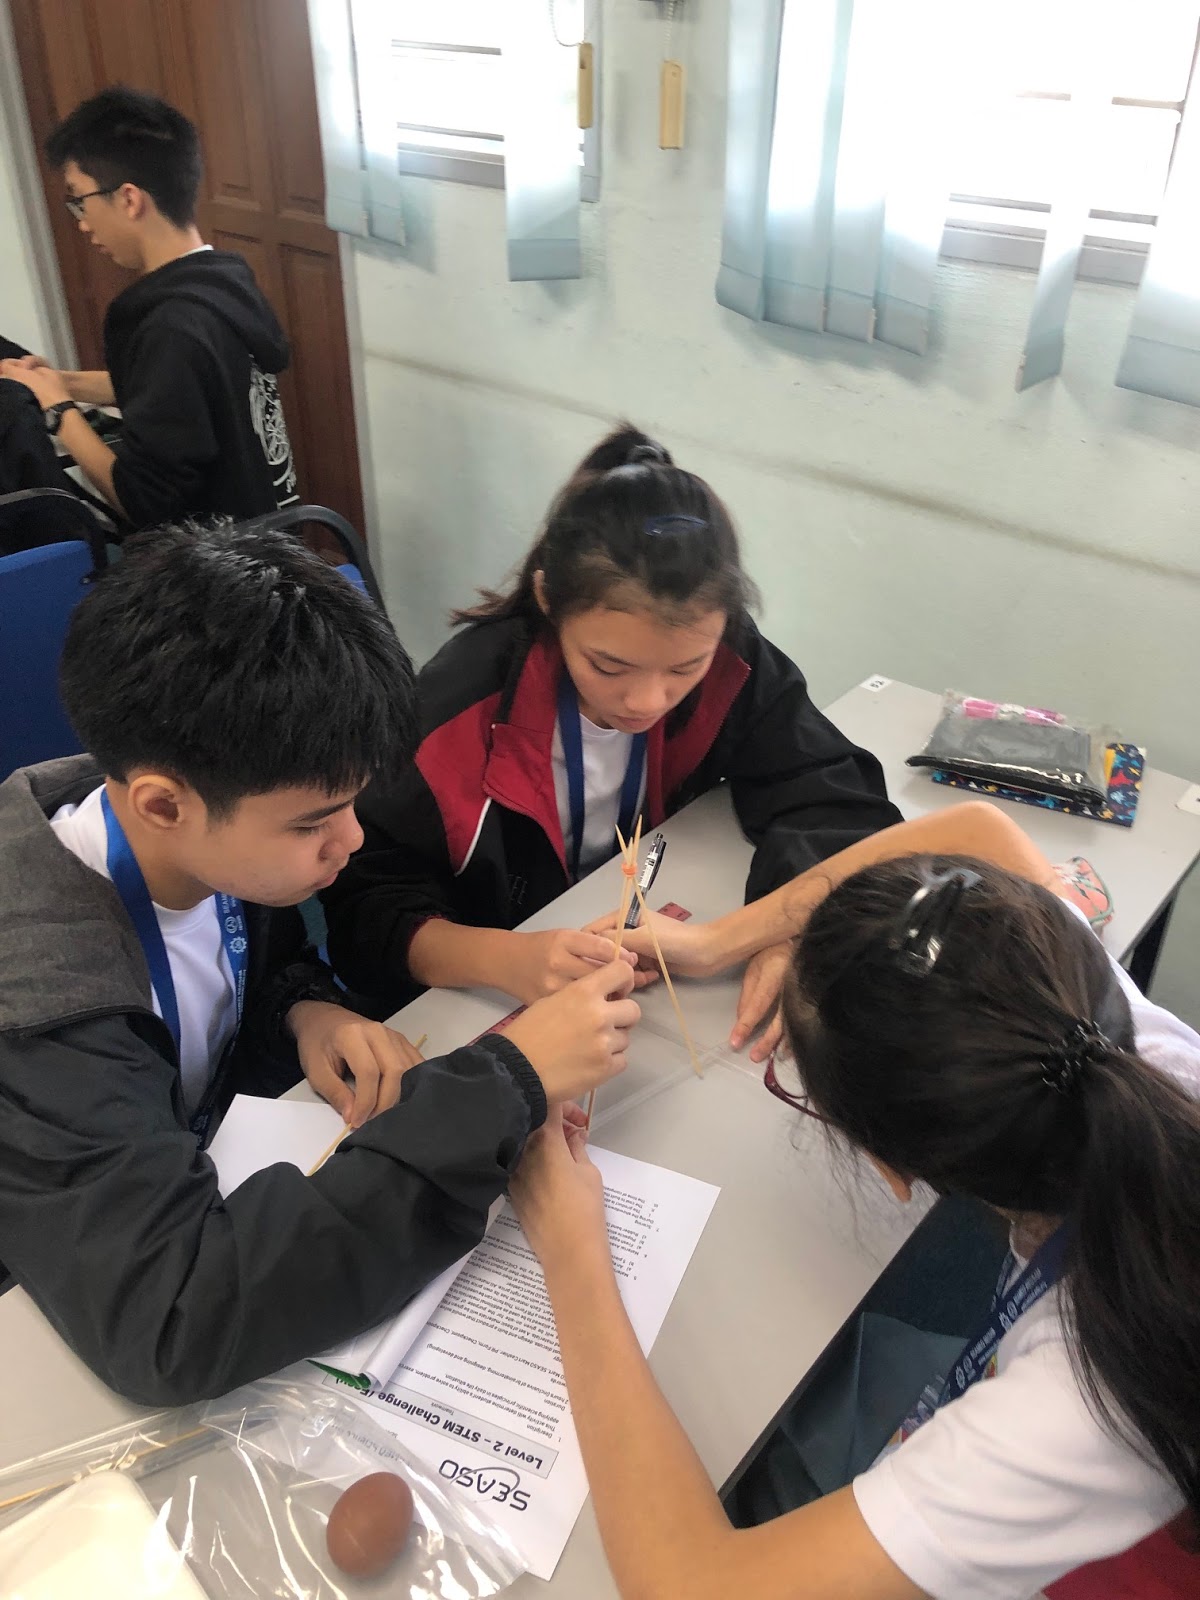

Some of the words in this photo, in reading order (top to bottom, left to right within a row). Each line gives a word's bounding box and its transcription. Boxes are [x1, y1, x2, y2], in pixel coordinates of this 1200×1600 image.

[489, 1261, 508, 1272] product
[491, 1268, 502, 1276] own
[507, 1268, 519, 1276] their
[468, 1273, 490, 1285] materials
[517, 1279, 536, 1289] product
[466, 1286, 479, 1294] used
[469, 1281, 483, 1289] price
[482, 1285, 493, 1293] own
[457, 1290, 480, 1302] materials
[509, 1289, 522, 1297] right
[450, 1301, 464, 1309] given
[466, 1300, 487, 1311] purpose
[479, 1298, 503, 1311] additional
[491, 1296, 504, 1305] form
[508, 1296, 529, 1307] material
[528, 1296, 540, 1304] with
[451, 1308, 466, 1317] would
[507, 1309, 520, 1317] used
[529, 1304, 541, 1312] Each
[478, 1312, 501, 1324] materials
[536, 1313, 551, 1322] given
[475, 1318, 494, 1329] product
[500, 1320, 514, 1329] basic
[523, 1322, 537, 1330] given
[531, 1318, 551, 1329] allowed
[517, 1334, 534, 1344] design
[453, 1353, 463, 1361] and
[518, 1357, 530, 1365] Mart
[462, 1357, 486, 1370] designing
[529, 1361, 547, 1372] SEASO
[435, 1377, 449, 1386] solve
[453, 1385, 470, 1395] ability
[473, 1385, 486, 1394] daily
[526, 1383, 550, 1397] (inclusive
[469, 1391, 491, 1404] student's
[491, 1392, 516, 1406] principles
[549, 1392, 565, 1403] hours
[376, 1390, 441, 1425] Challenge
[430, 1401, 454, 1416] Teamwork
[491, 1400, 517, 1415] determine
[515, 1402, 538, 1415] scientific
[543, 1398, 565, 1411] Duration
[516, 1411, 527, 1419] will
[526, 1415, 545, 1426] activity
[537, 1411, 559, 1424] applying
[441, 1419, 481, 1443] STEM
[544, 1422, 556, 1431] This
[492, 1440, 503, 1452] 2
[504, 1445, 543, 1469] Level
[437, 1458, 531, 1512] SEASO
